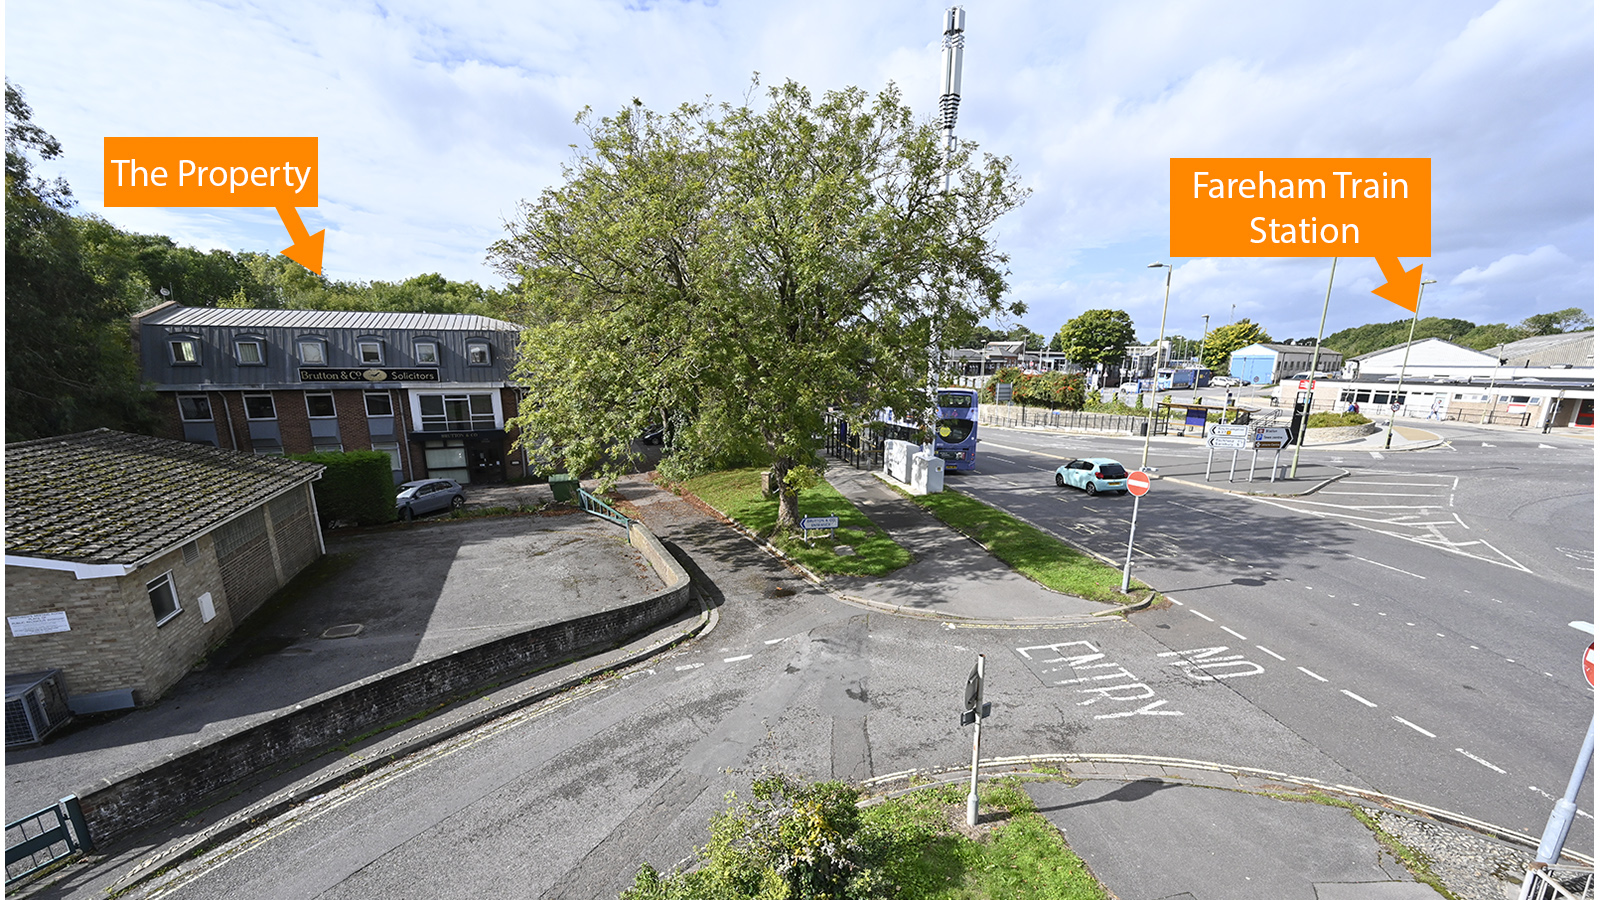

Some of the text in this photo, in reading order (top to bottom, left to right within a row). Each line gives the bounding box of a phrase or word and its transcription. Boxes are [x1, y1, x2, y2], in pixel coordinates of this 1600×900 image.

[300, 370, 339, 381] Brutton
[391, 371, 435, 381] Solicitors
[1016, 640, 1184, 719] ENTRY
[1157, 646, 1265, 681] NO
